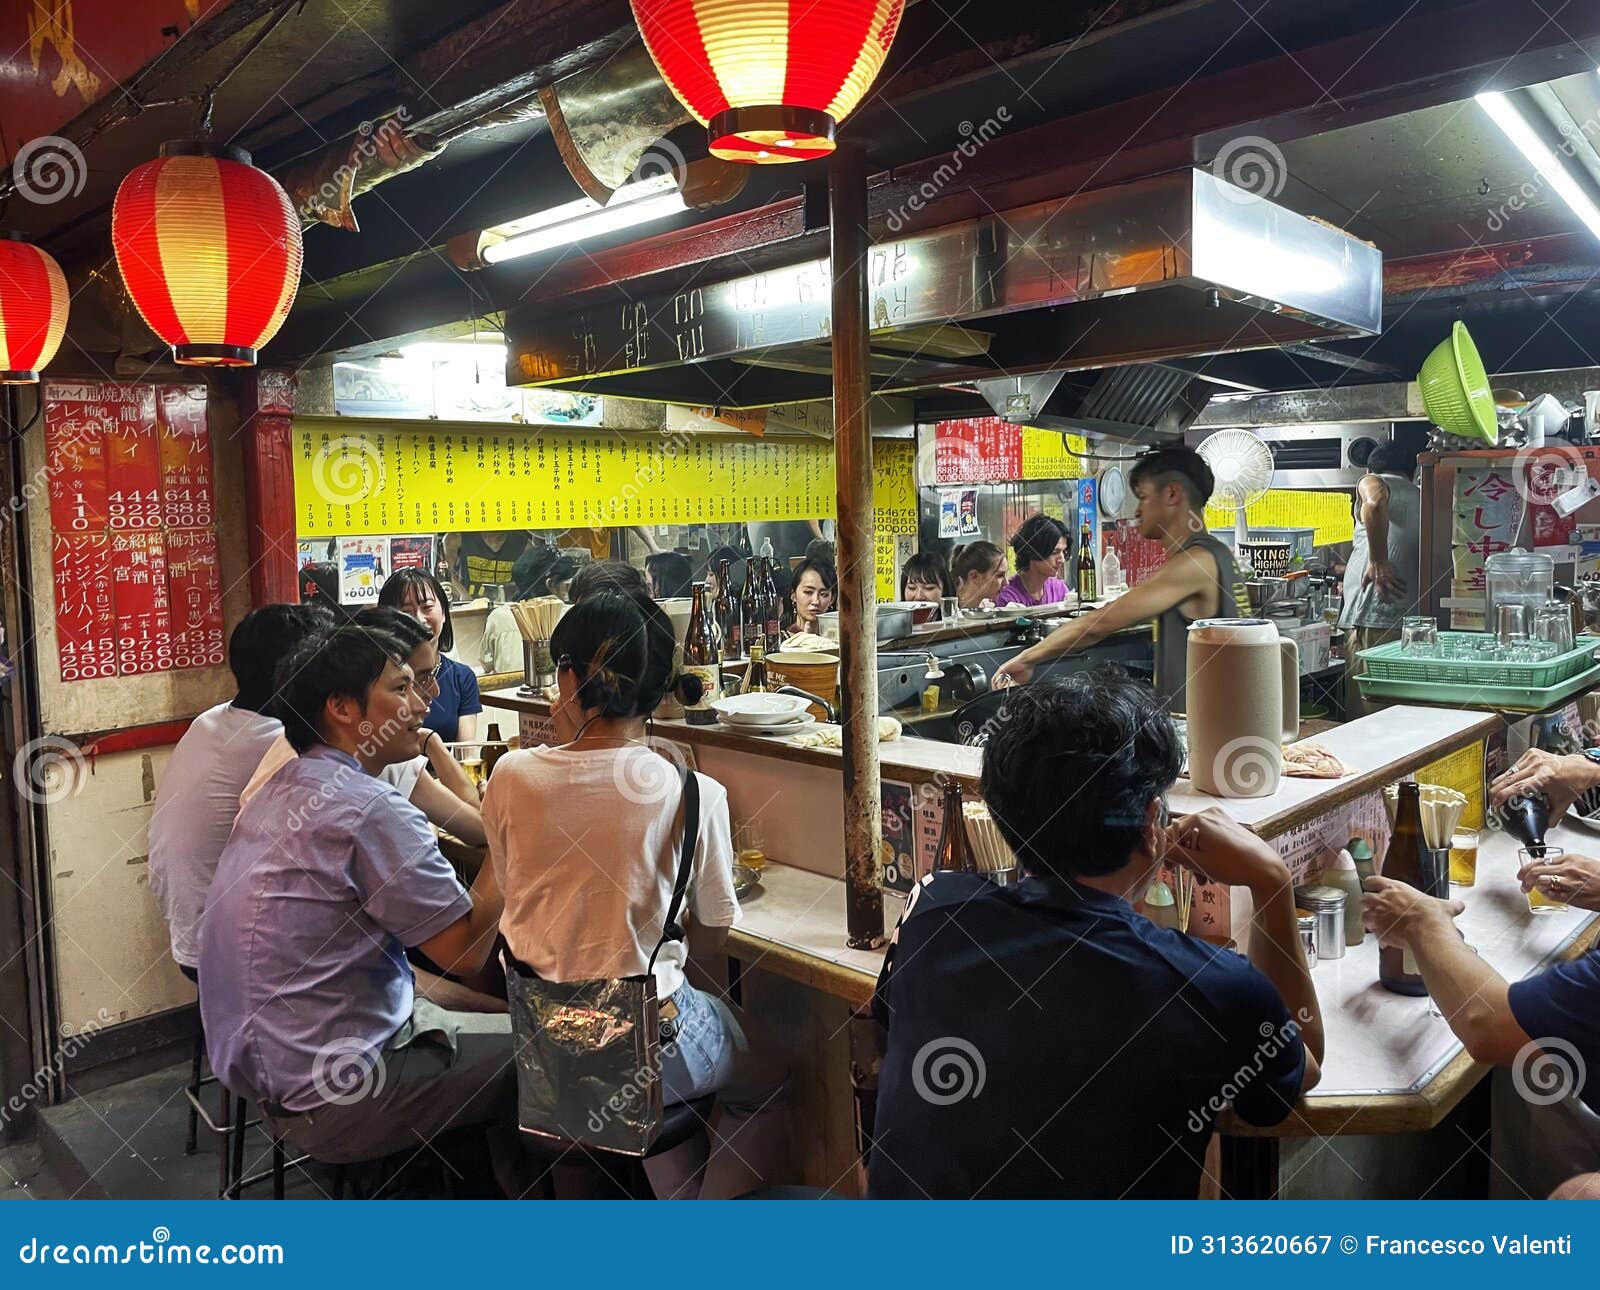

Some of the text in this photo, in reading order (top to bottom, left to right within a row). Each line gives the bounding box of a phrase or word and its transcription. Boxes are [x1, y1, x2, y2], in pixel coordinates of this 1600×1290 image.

[108, 490, 126, 528] 490
[127, 489, 144, 528] 420
[145, 489, 161, 527] 420
[165, 489, 180, 527] 680
[180, 489, 194, 527] 480
[196, 489, 211, 526] 480
[112, 534, 131, 582] 金宮
[1254, 549, 1290, 561] KINGS
[1254, 560, 1288, 569] HIGHWA
[55, 536, 79, 680] ハイボール 420
[74, 535, 97, 678] ジンジャーハイ 450
[98, 638, 116, 676] 520
[120, 637, 138, 674] 960
[138, 630, 154, 672] 1750
[156, 632, 173, 669] 360
[173, 632, 190, 667] 450
[191, 630, 207, 666] 330
[209, 630, 224, 664] 820
[1202, 889, 1216, 925] 飲み
